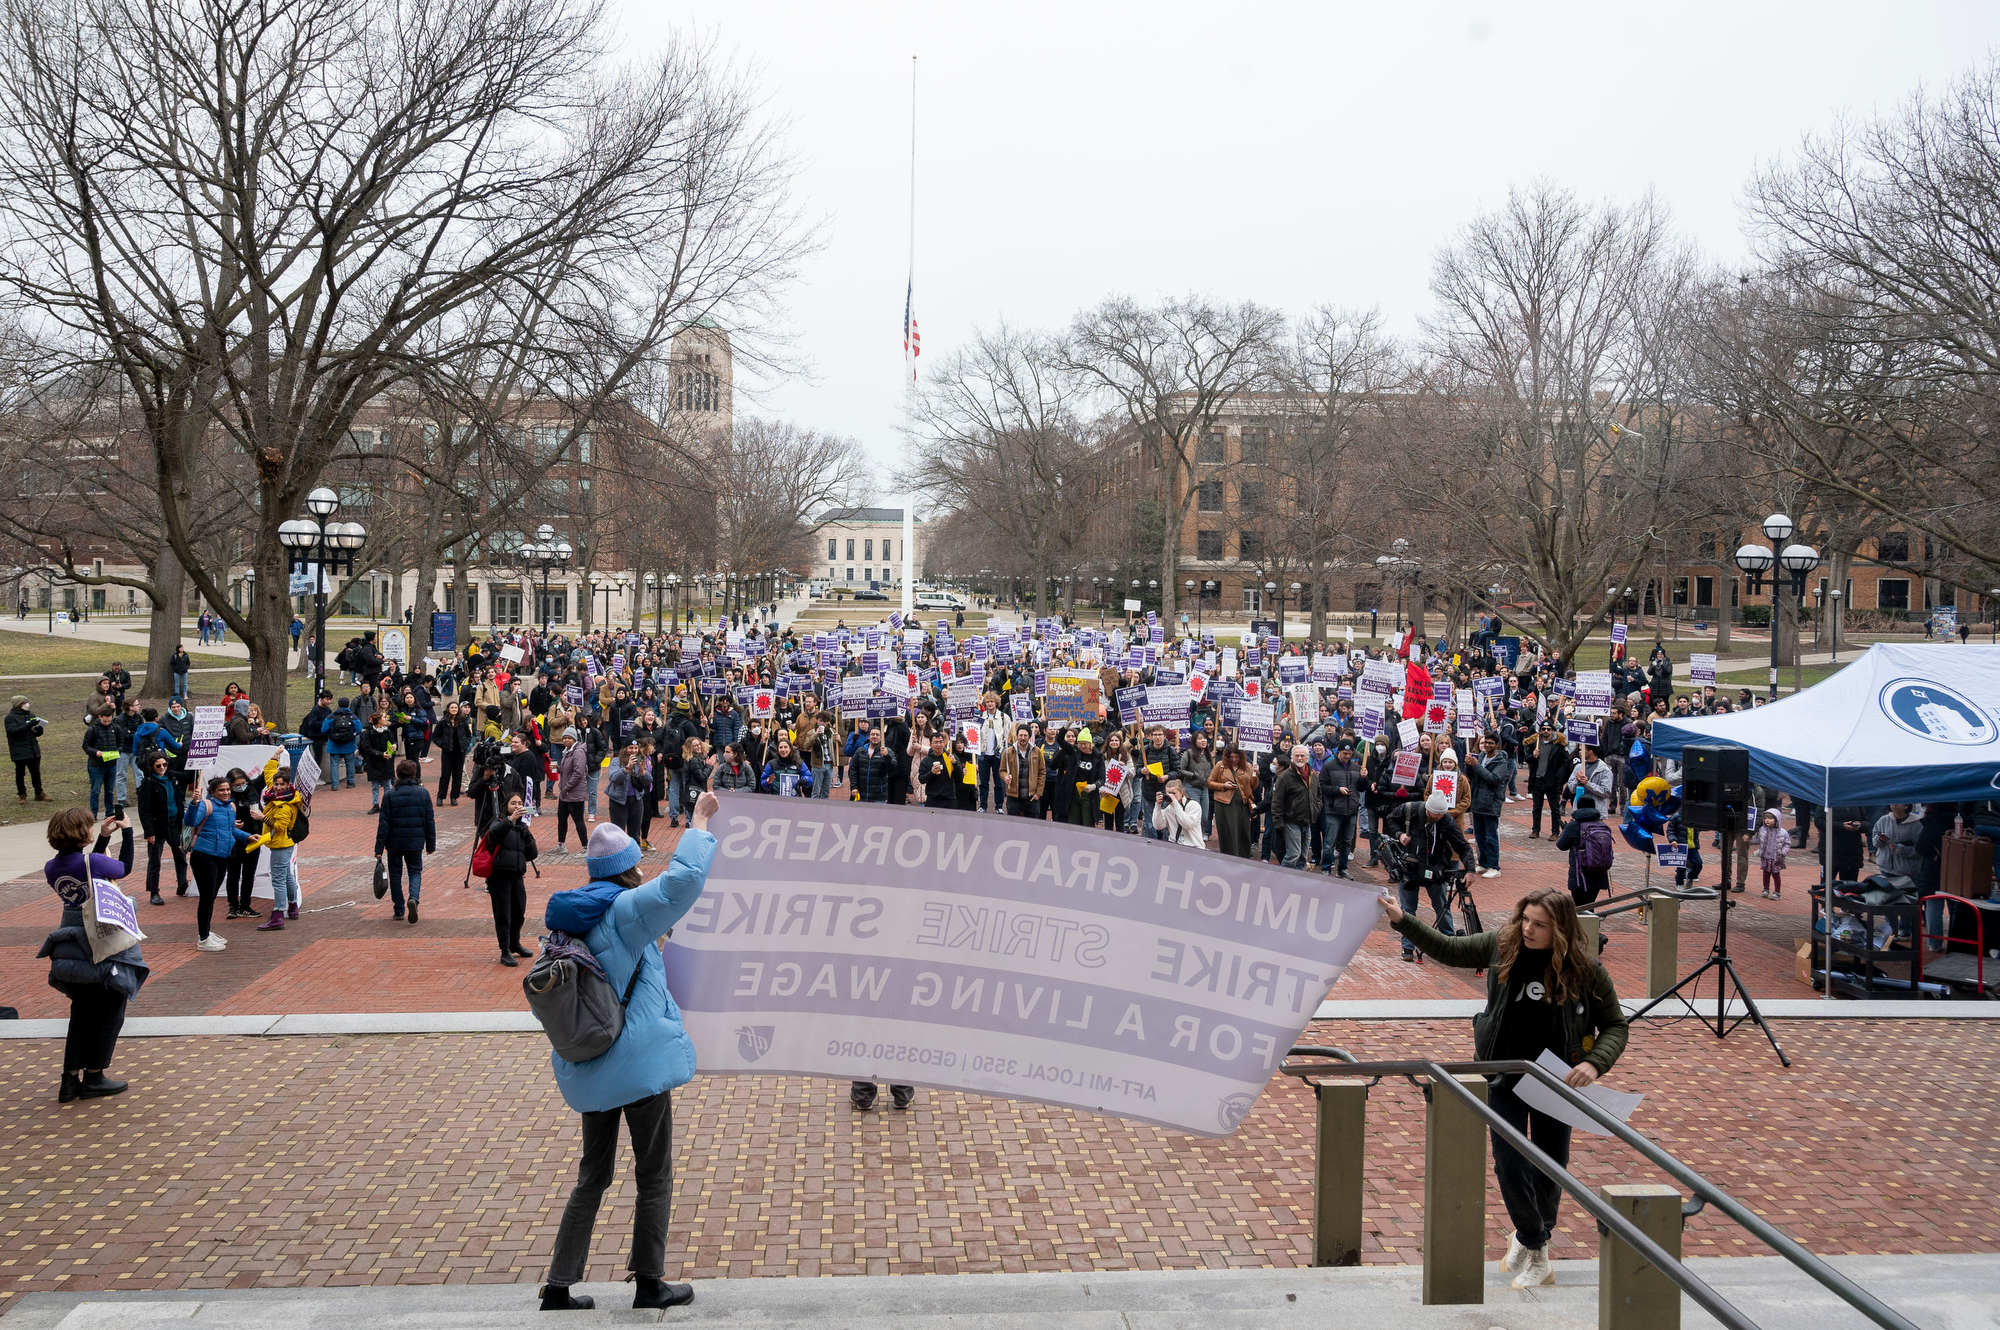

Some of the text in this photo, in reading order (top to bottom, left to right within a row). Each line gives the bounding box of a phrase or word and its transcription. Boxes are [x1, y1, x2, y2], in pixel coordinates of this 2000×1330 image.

[1408, 687, 1423, 695] LESS
[1406, 696, 1427, 705] LIVING
[1071, 711, 1097, 720] POWER
[1644, 789, 1668, 803] M
[102, 908, 135, 930] LIVING
